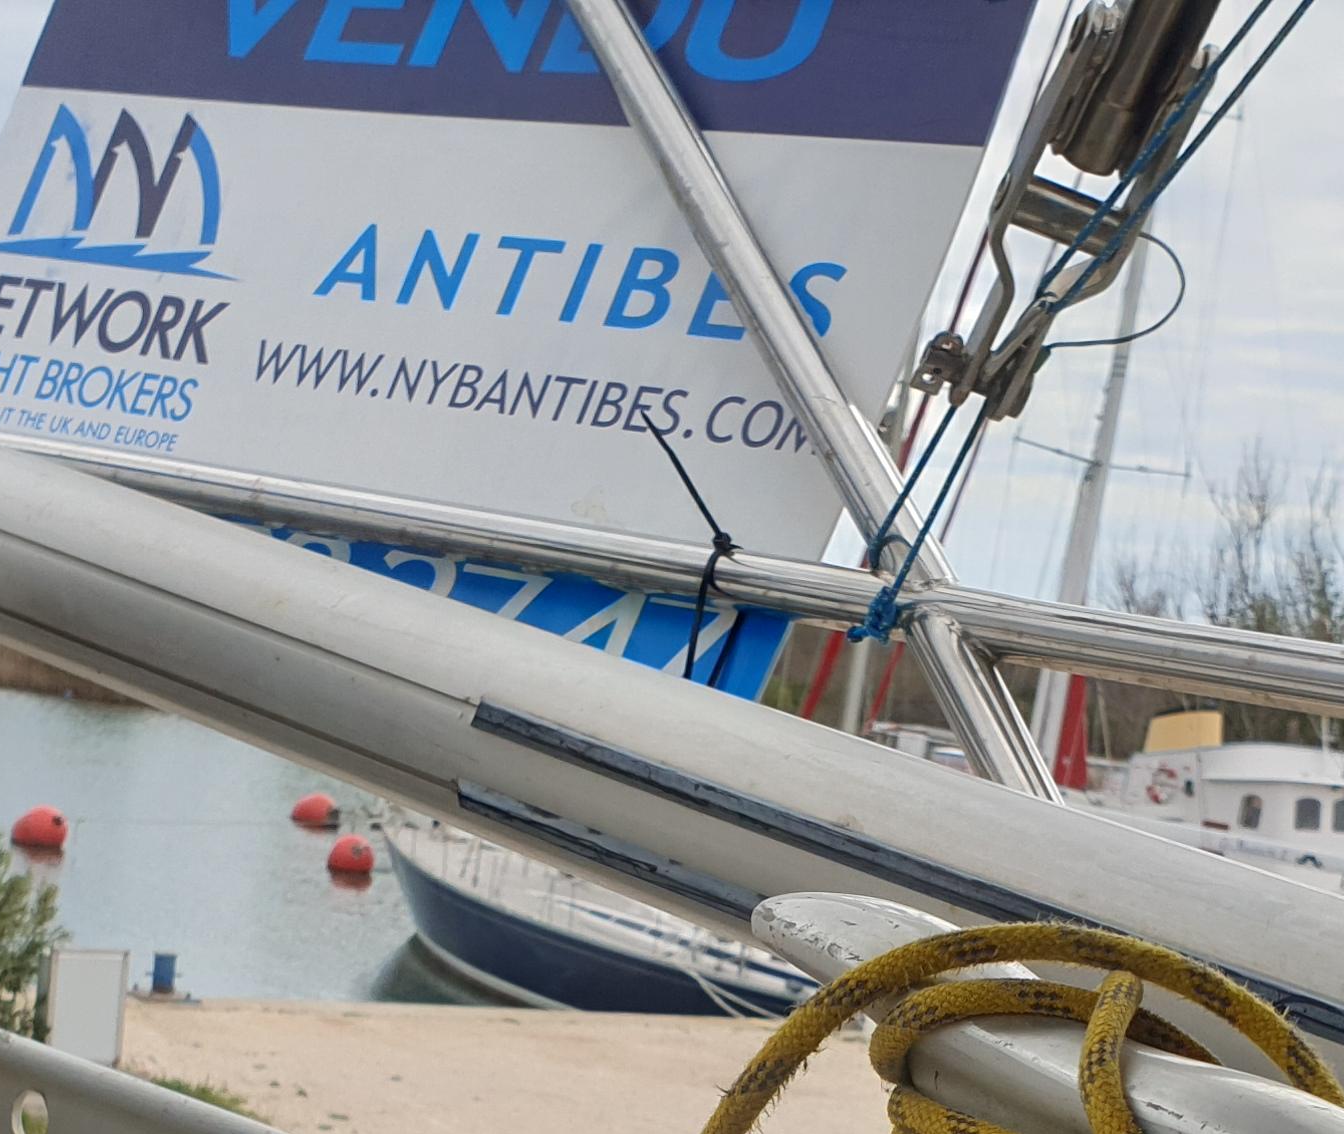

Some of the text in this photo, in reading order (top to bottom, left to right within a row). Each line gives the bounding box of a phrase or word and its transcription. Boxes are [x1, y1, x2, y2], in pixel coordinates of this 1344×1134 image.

[312, 223, 848, 342] ANTIBES
[35, 359, 199, 422] BROKERS
[17, 409, 48, 430] THE
[50, 415, 74, 435] UK
[71, 420, 111, 441] AND
[114, 426, 180, 452] EUROPE
